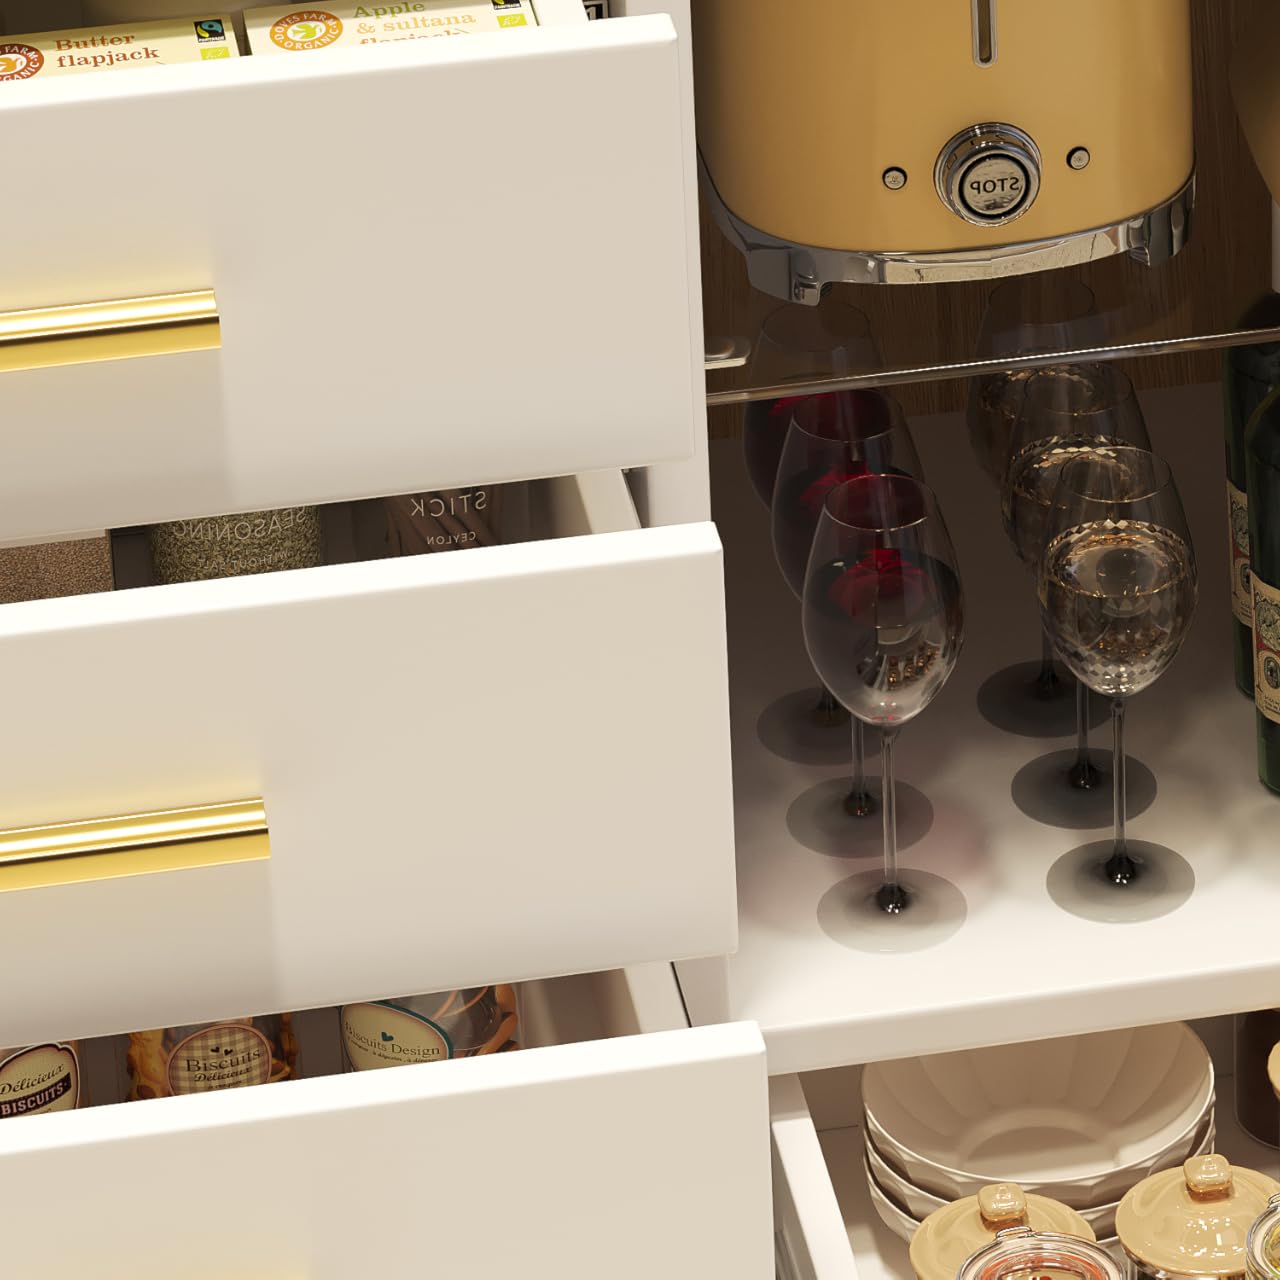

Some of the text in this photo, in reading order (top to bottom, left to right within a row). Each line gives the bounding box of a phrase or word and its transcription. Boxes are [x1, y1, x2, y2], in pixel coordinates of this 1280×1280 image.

[353, 2, 426, 20] Apple
[356, 14, 476, 34] & sultana
[55, 33, 136, 52] Butter
[56, 47, 161, 69] flapjack
[345, 1021, 388, 1052] Biscuits
[391, 1043, 440, 1058] Design
[185, 1048, 261, 1073] Biscuits
[0, 1064, 65, 1095] Délicieux
[194, 1066, 253, 1082] Délicieux
[1, 1081, 64, 1115] BISCUITS
